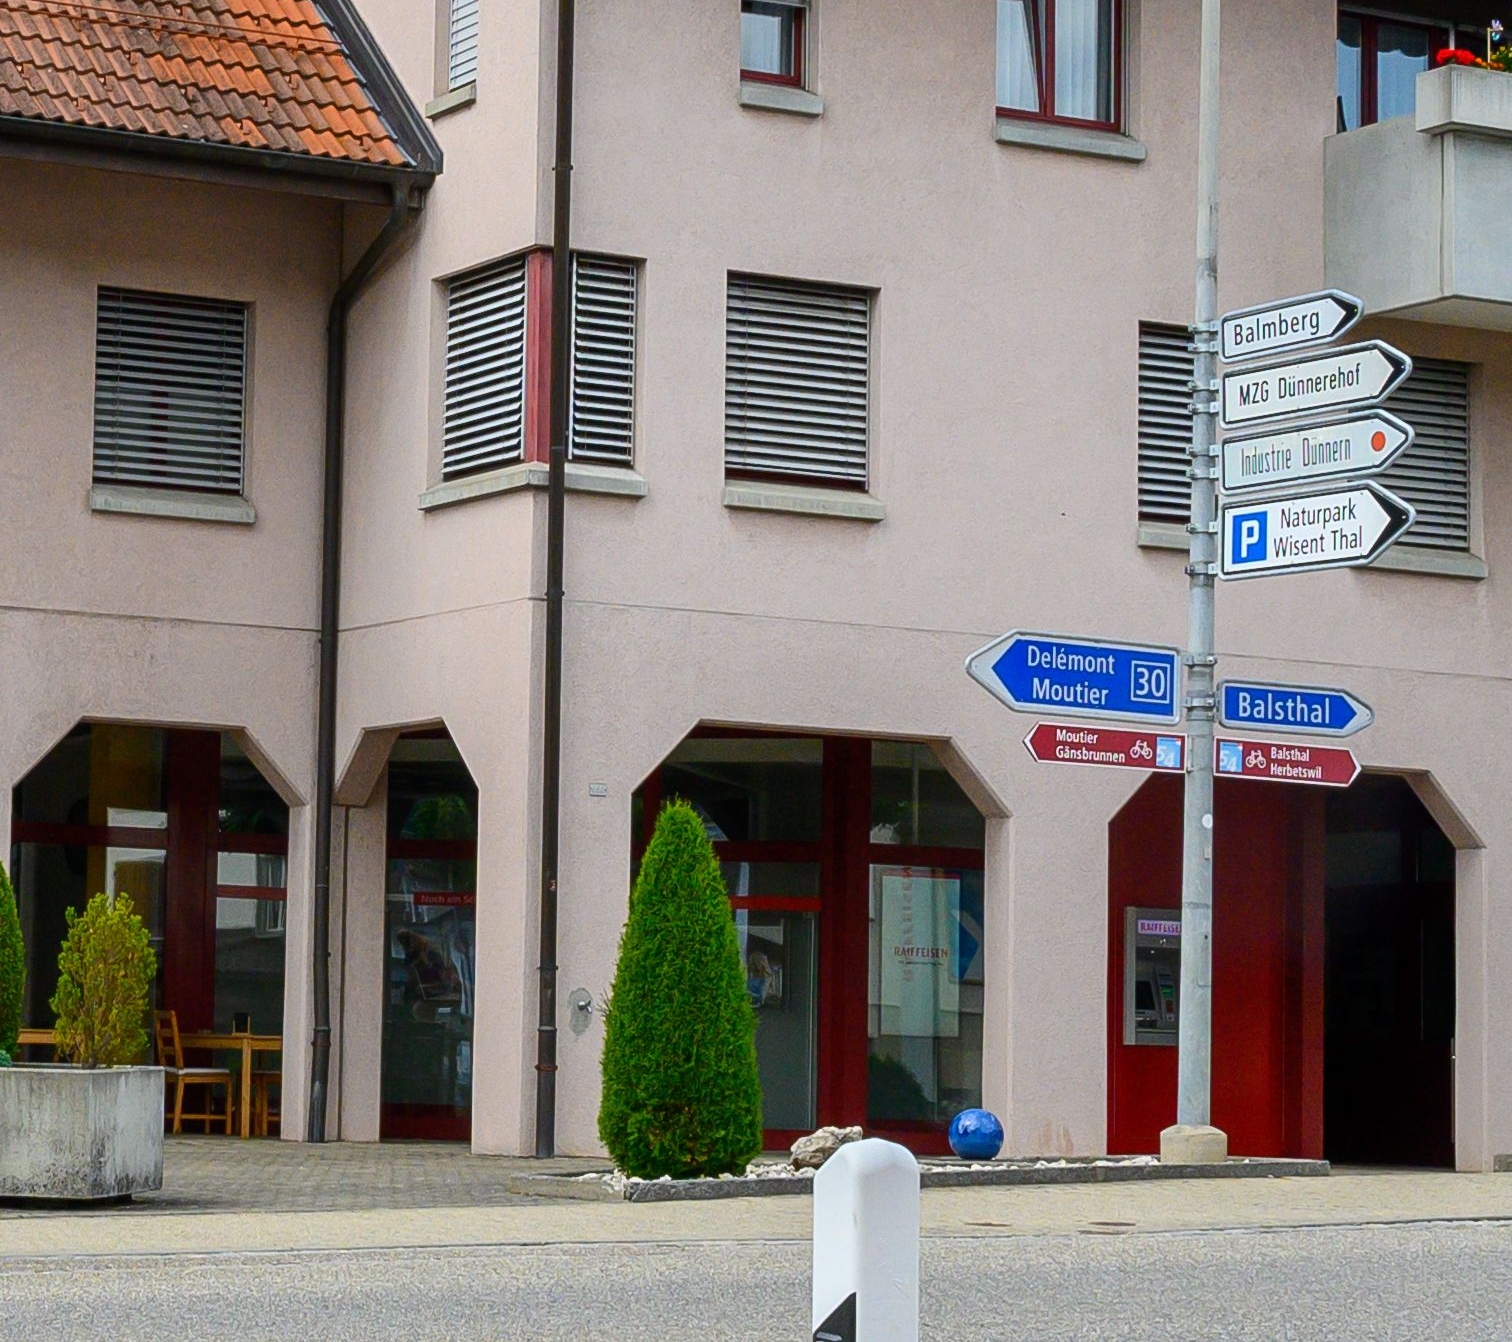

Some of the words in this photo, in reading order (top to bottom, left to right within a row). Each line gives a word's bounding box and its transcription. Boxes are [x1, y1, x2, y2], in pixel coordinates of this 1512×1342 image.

[1234, 311, 1320, 346] Balmberg
[1239, 380, 1269, 406] MZG
[1278, 362, 1362, 399] Dünnerehof
[1241, 442, 1292, 477] Industrie
[1302, 436, 1351, 467] Dünnern
[1280, 497, 1357, 529] Naturpark
[1240, 519, 1260, 559] P
[1273, 535, 1325, 559] Wisent
[1331, 525, 1363, 551] Thal
[1027, 644, 1115, 675] Delémont
[1032, 677, 1109, 706] Moutier
[1135, 667, 1165, 697] 30
[1238, 691, 1330, 724] Balsthal
[1056, 728, 1098, 744] Moutier
[1055, 745, 1126, 763] Gänsbrunnen
[1156, 745, 1175, 767] 54
[1219, 749, 1237, 772] 54
[1270, 746, 1310, 762] Balsthal
[1270, 763, 1322, 779] Herbetswil
[1140, 922, 1180, 933] RAIFFEISE
[893, 946, 948, 958] RAIFFEISEN
